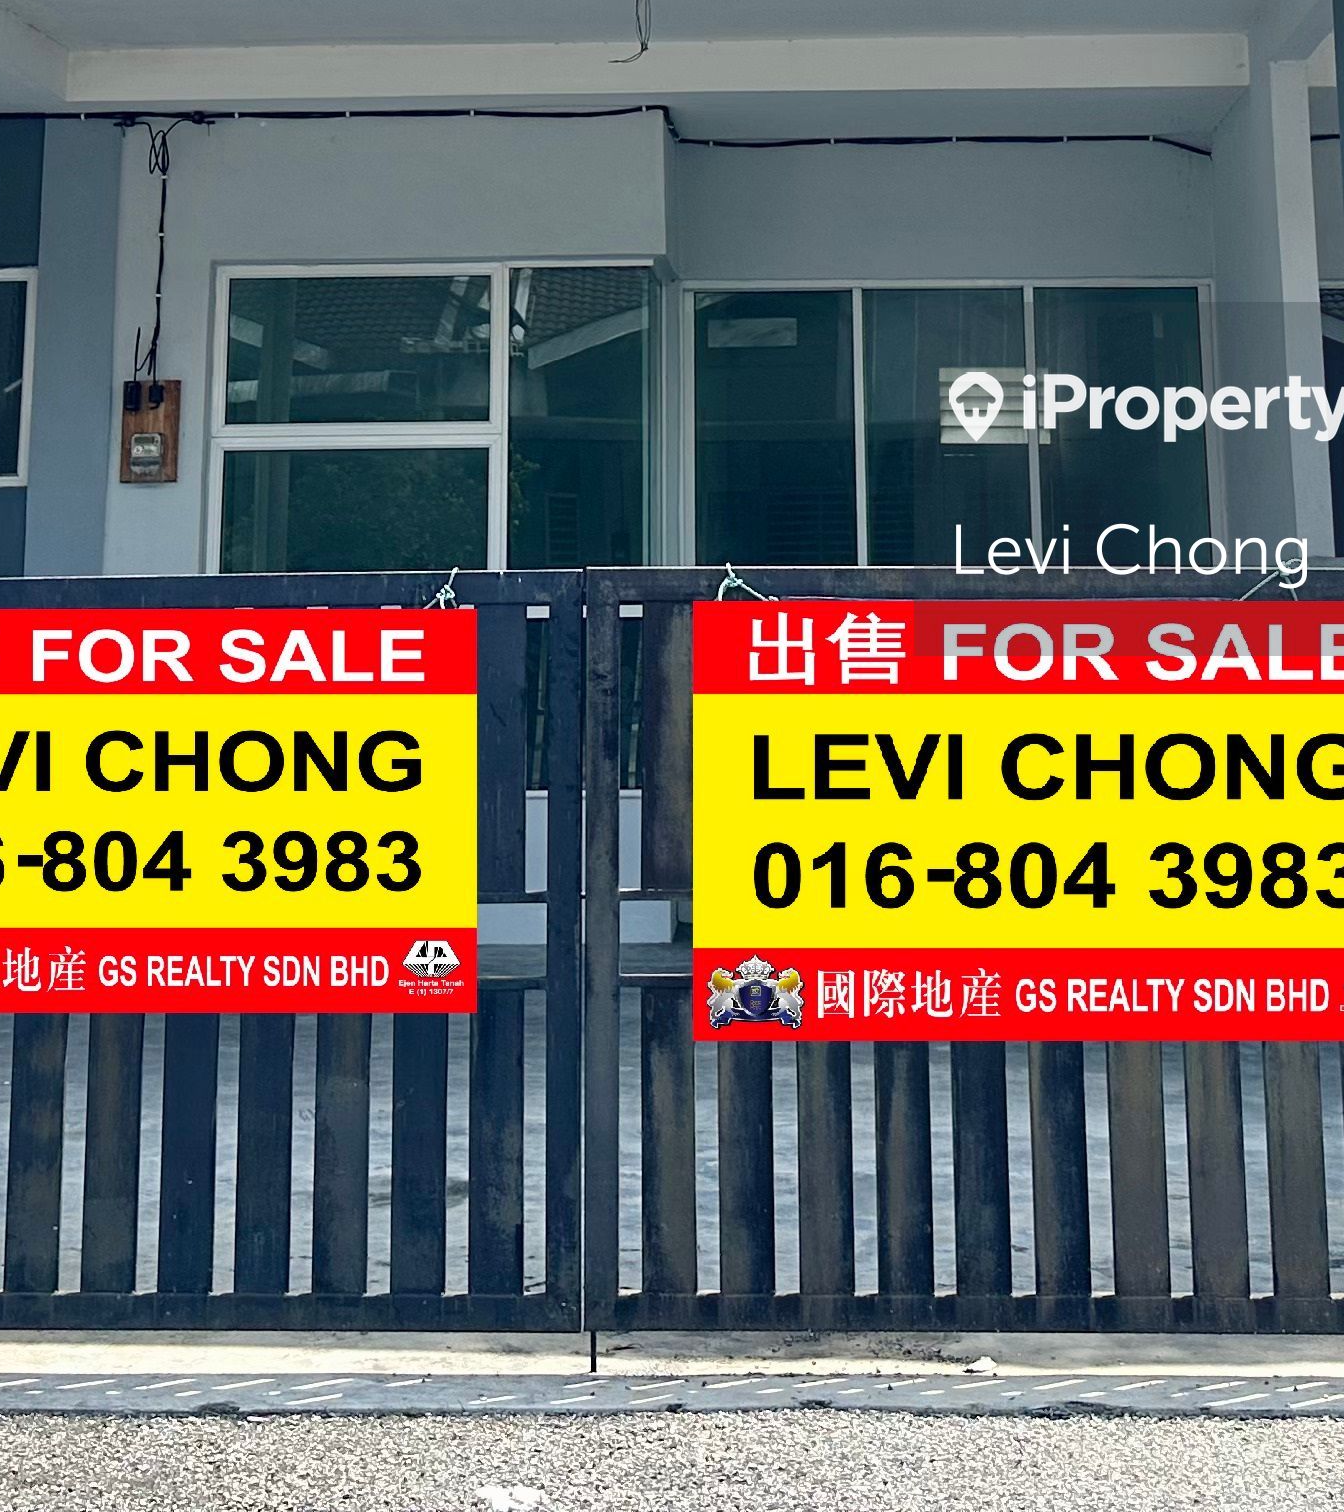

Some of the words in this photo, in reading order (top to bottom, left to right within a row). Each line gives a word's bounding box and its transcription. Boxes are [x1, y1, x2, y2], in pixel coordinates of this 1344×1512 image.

[31, 628, 193, 683] FOR
[219, 628, 425, 683] SALE
[748, 611, 907, 686] 出售
[942, 622, 1118, 682] FOR
[85, 730, 422, 793] CHONG
[753, 733, 963, 800] LEVI
[221, 830, 422, 892] 3983
[753, 841, 1116, 909] 016-804
[98, 955, 137, 987] GS
[147, 955, 254, 987] REALTY
[263, 955, 320, 987] SDN
[330, 955, 390, 987] BHD
[1015, 978, 1057, 1013] GS
[1067, 978, 1186, 1012] REALTY
[1193, 978, 1255, 1013] SDN
[1266, 978, 1330, 1012] BHD
